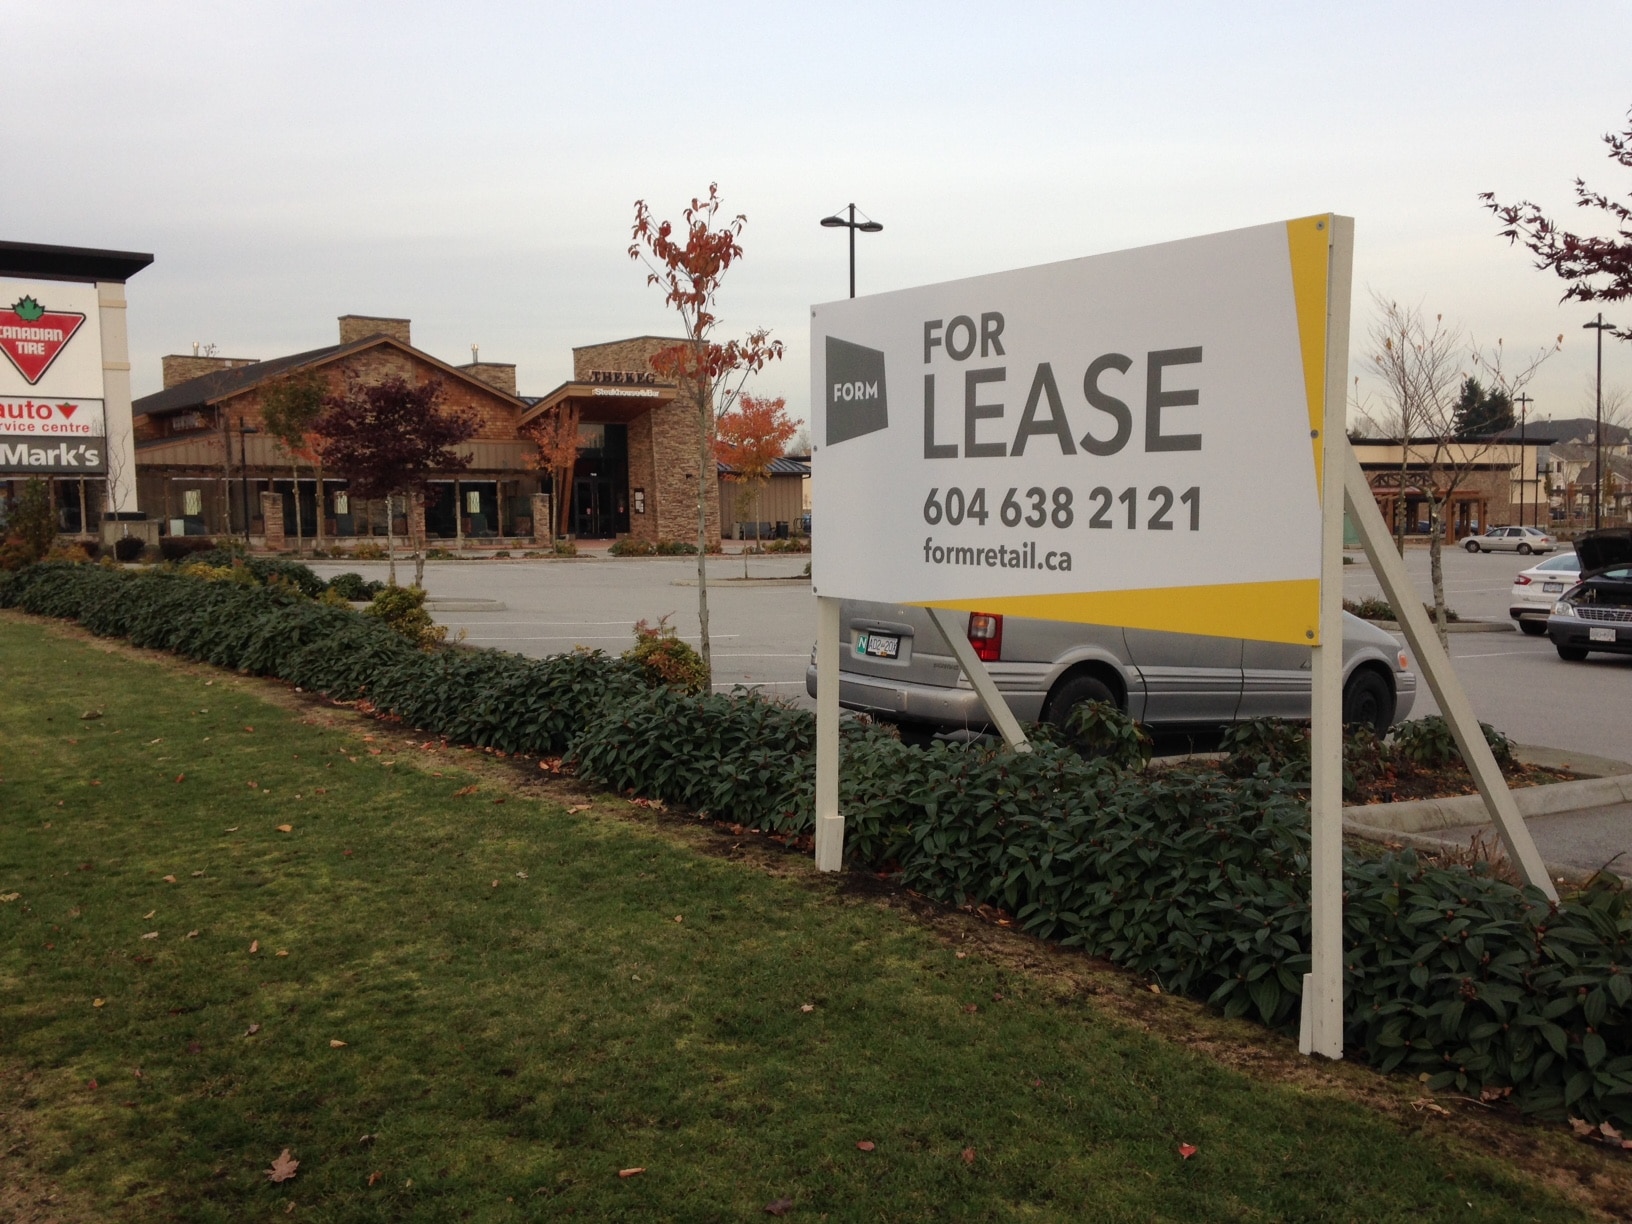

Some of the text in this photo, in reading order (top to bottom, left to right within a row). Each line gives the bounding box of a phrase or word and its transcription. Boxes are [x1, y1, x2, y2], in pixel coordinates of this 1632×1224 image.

[15, 341, 46, 355] TIRE
[923, 311, 1006, 364] FOR
[833, 380, 878, 402] FORM
[923, 345, 1203, 460] LEASE
[0, 421, 90, 433] rvice centre
[0, 442, 100, 467] Mark's
[923, 485, 1201, 532] 604 638 2121
[923, 536, 1073, 572] formretail.ca
